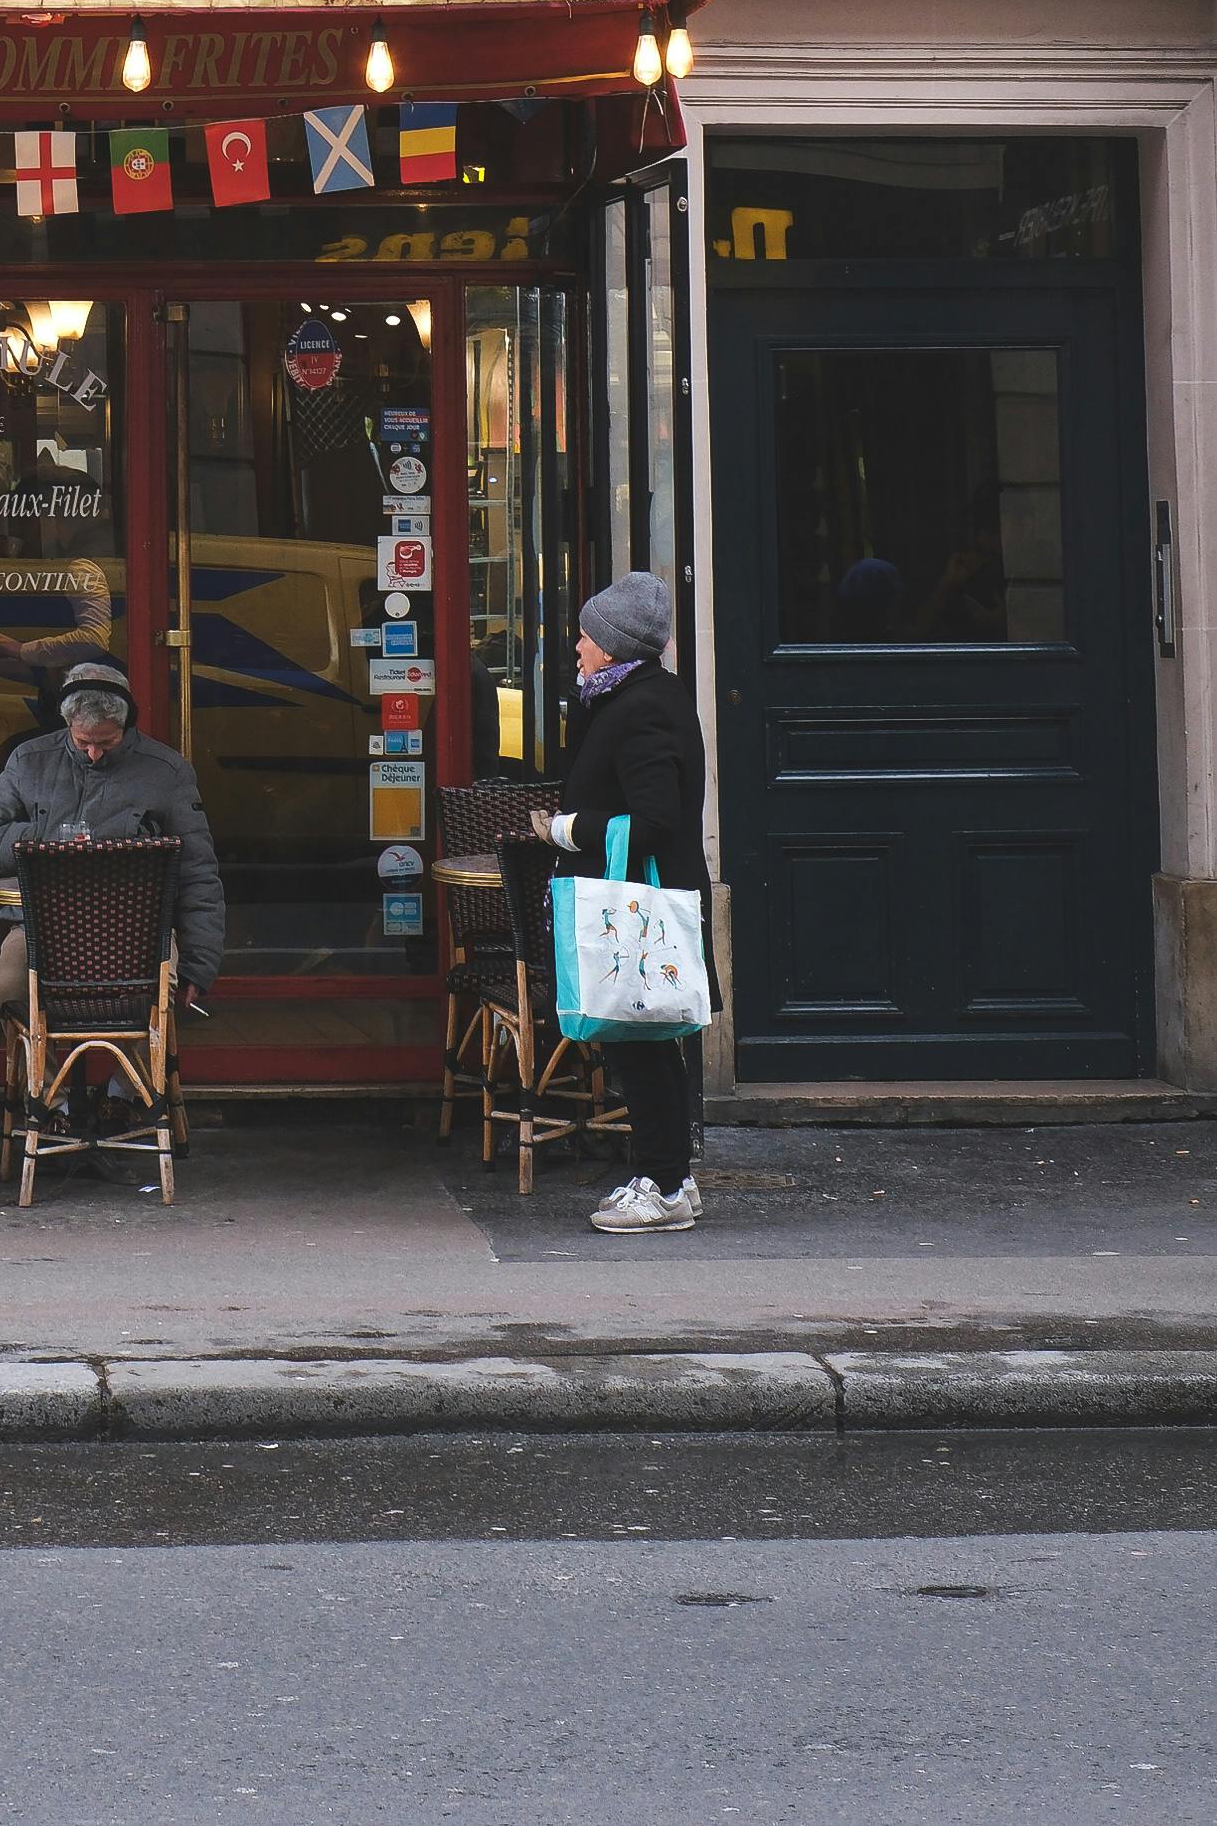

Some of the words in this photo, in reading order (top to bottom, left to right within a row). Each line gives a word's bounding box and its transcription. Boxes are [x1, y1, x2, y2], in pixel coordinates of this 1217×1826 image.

[155, 28, 344, 89] FRITES
[300, 340, 330, 349] LICENCE
[381, 764, 416, 774] Chèque
[381, 773, 421, 783] Déjeuner
